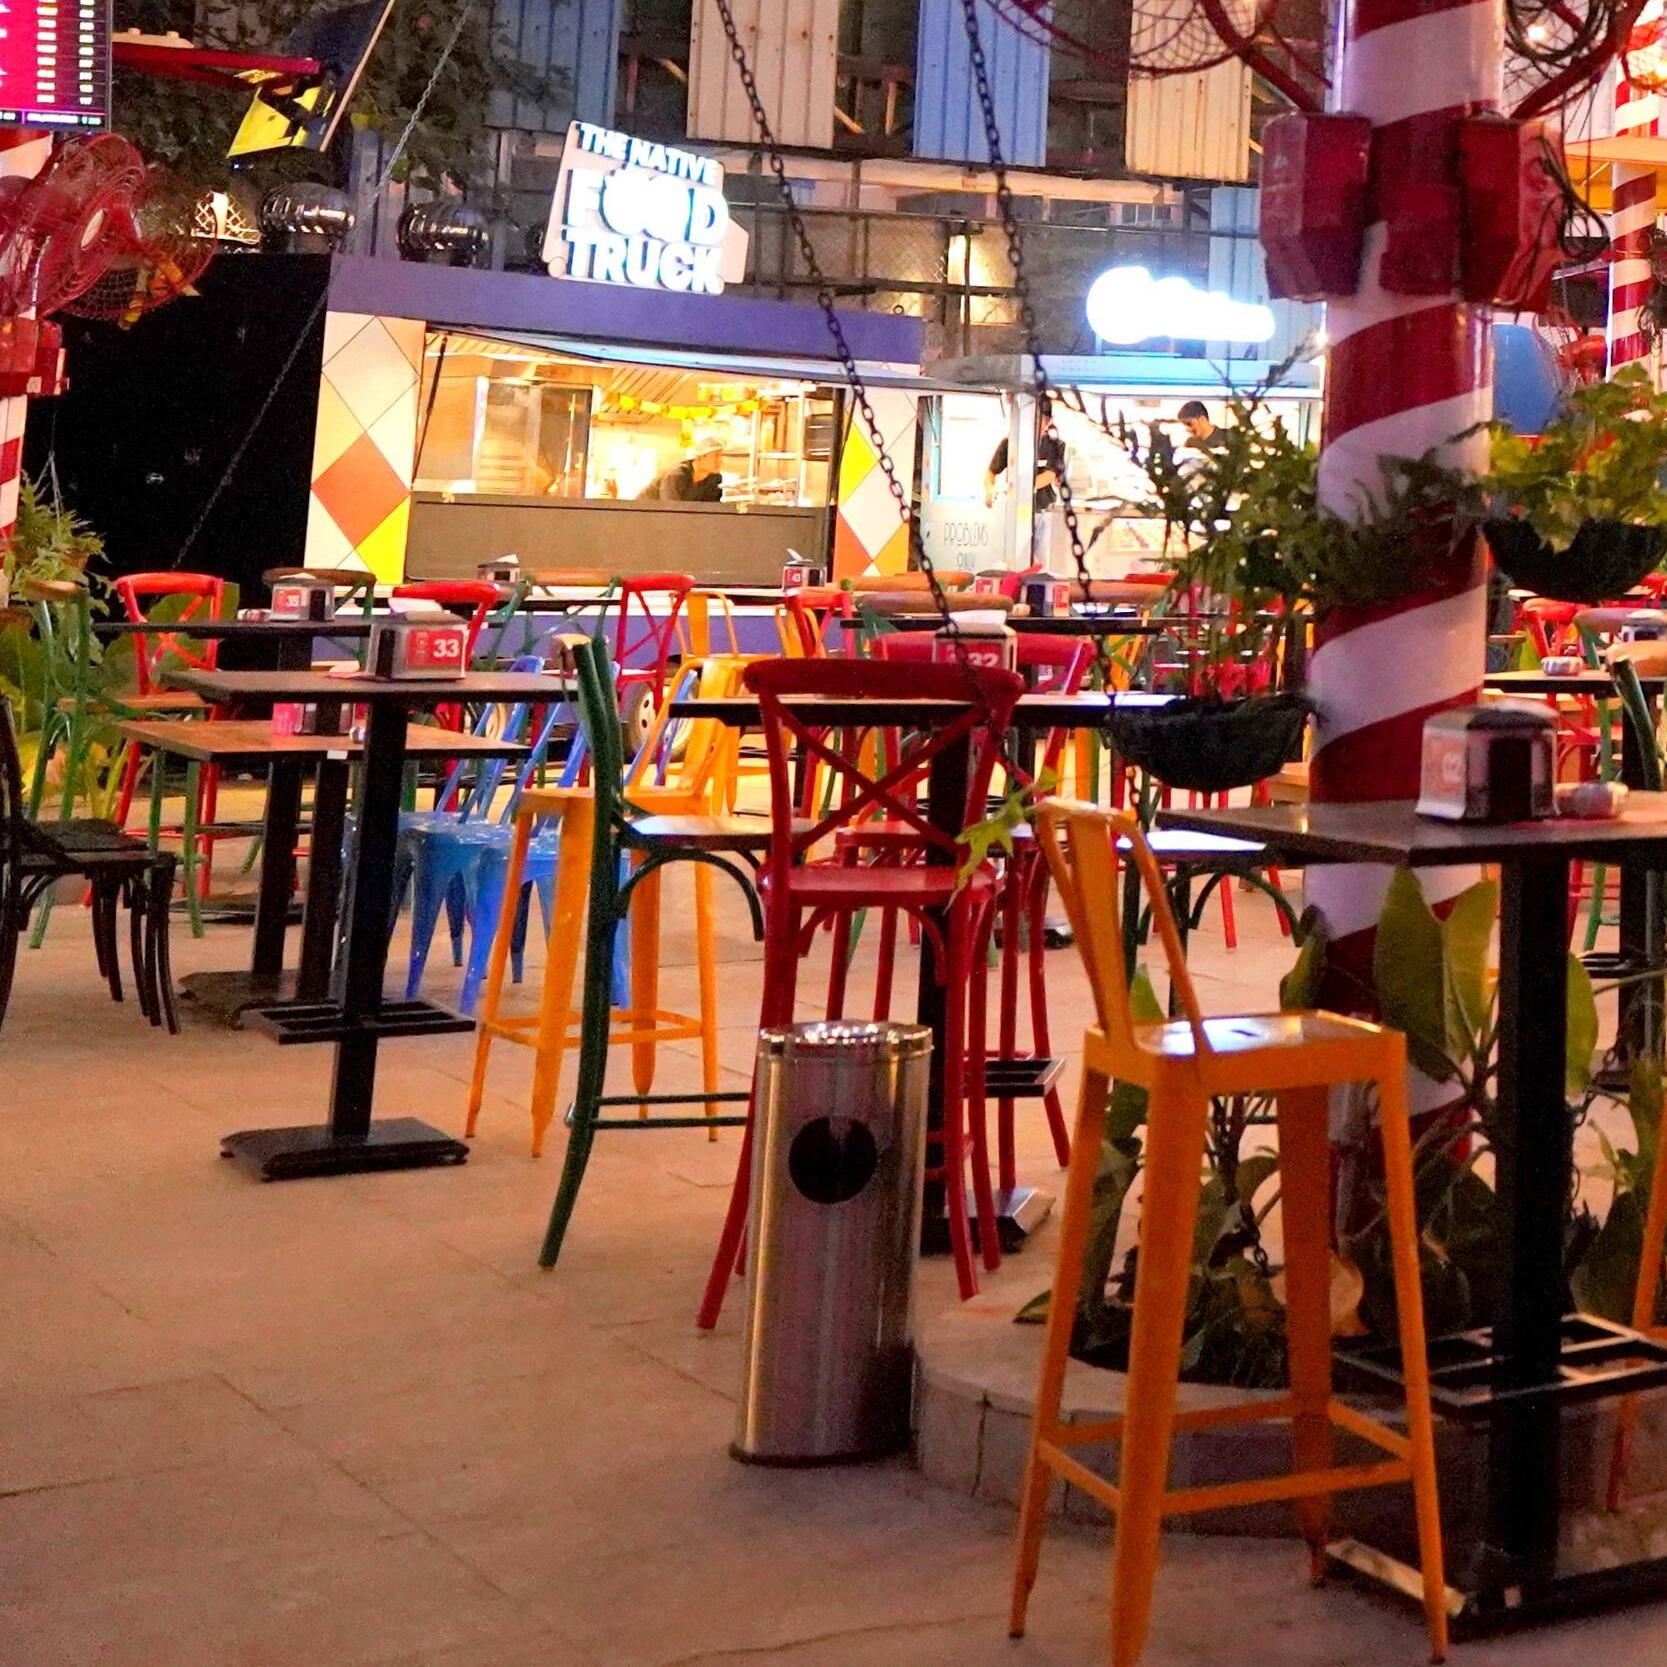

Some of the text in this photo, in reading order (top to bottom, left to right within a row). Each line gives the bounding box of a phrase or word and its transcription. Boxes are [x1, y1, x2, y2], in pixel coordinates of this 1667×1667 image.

[576, 122, 719, 184] THE NATIVE
[564, 167, 729, 245] FOOD
[562, 227, 724, 294] TRUCK
[943, 522, 989, 547] PROBLEMS
[432, 639, 461, 659] 33
[968, 651, 998, 669] 32
